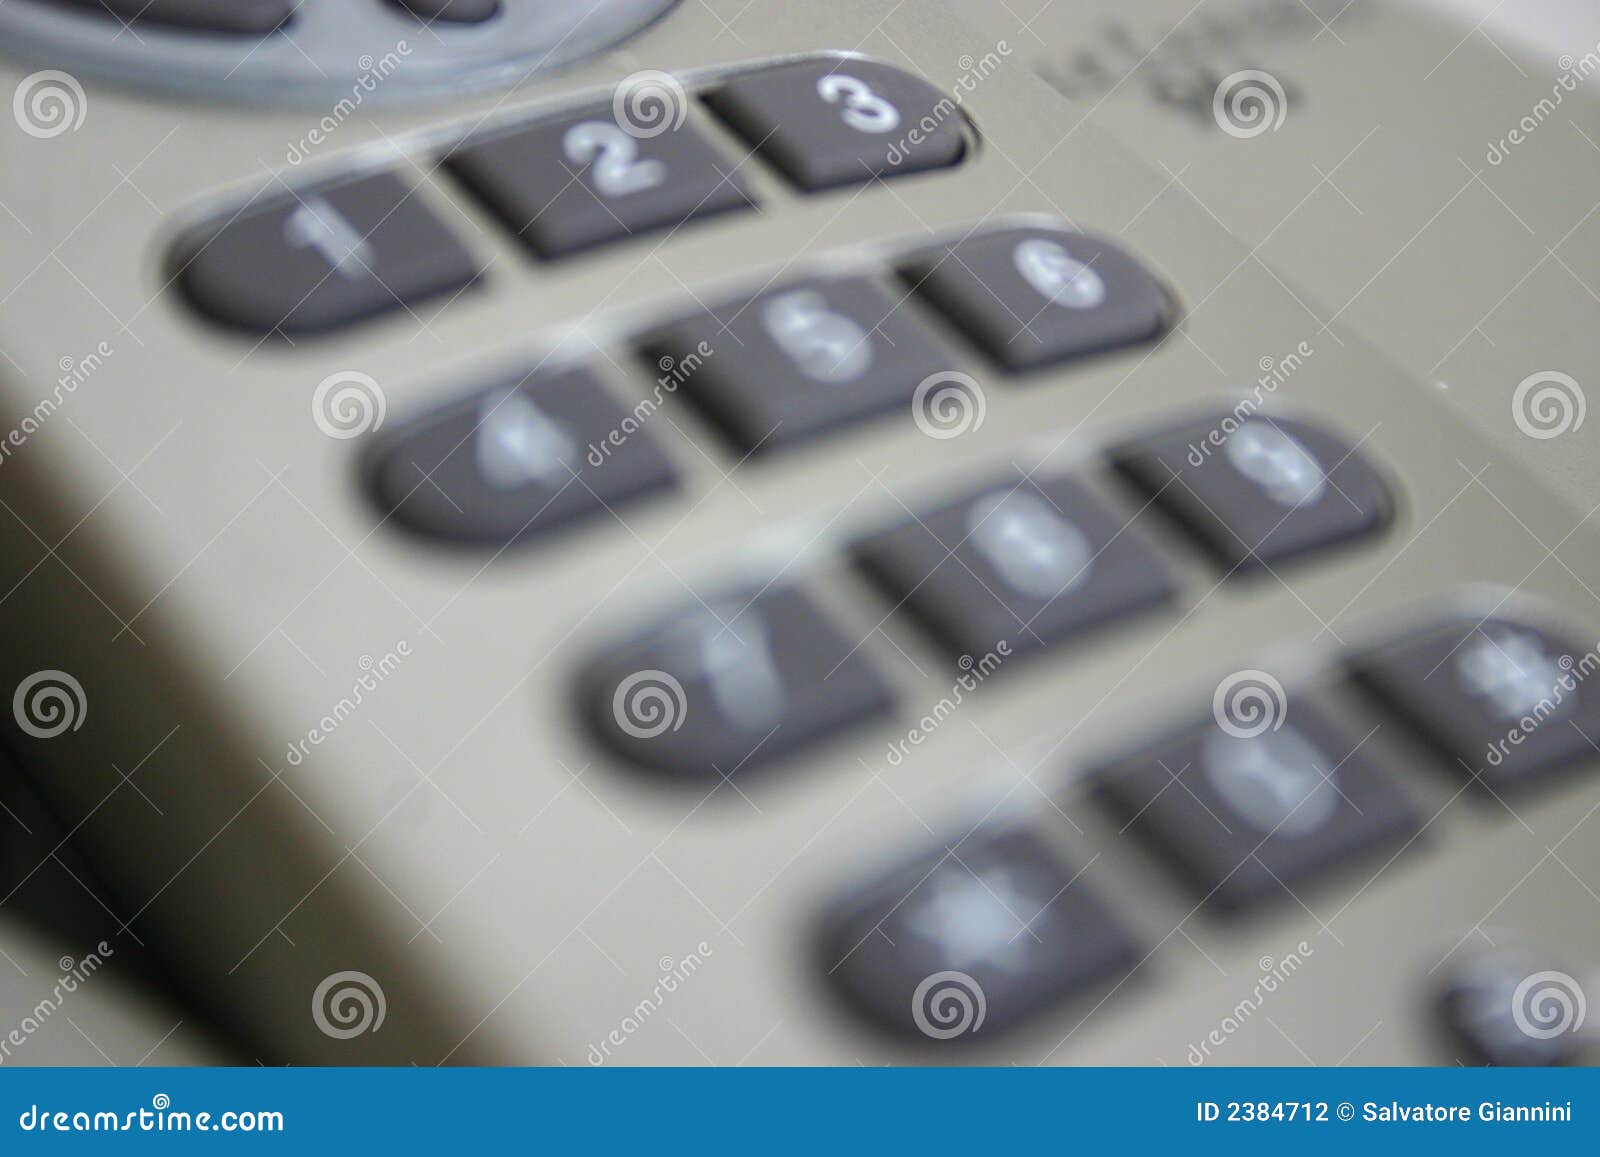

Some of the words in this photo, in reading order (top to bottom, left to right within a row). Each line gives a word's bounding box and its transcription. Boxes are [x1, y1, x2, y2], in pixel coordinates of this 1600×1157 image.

[817, 73, 901, 134] 3
[563, 119, 669, 197] 2
[284, 196, 375, 278] 1
